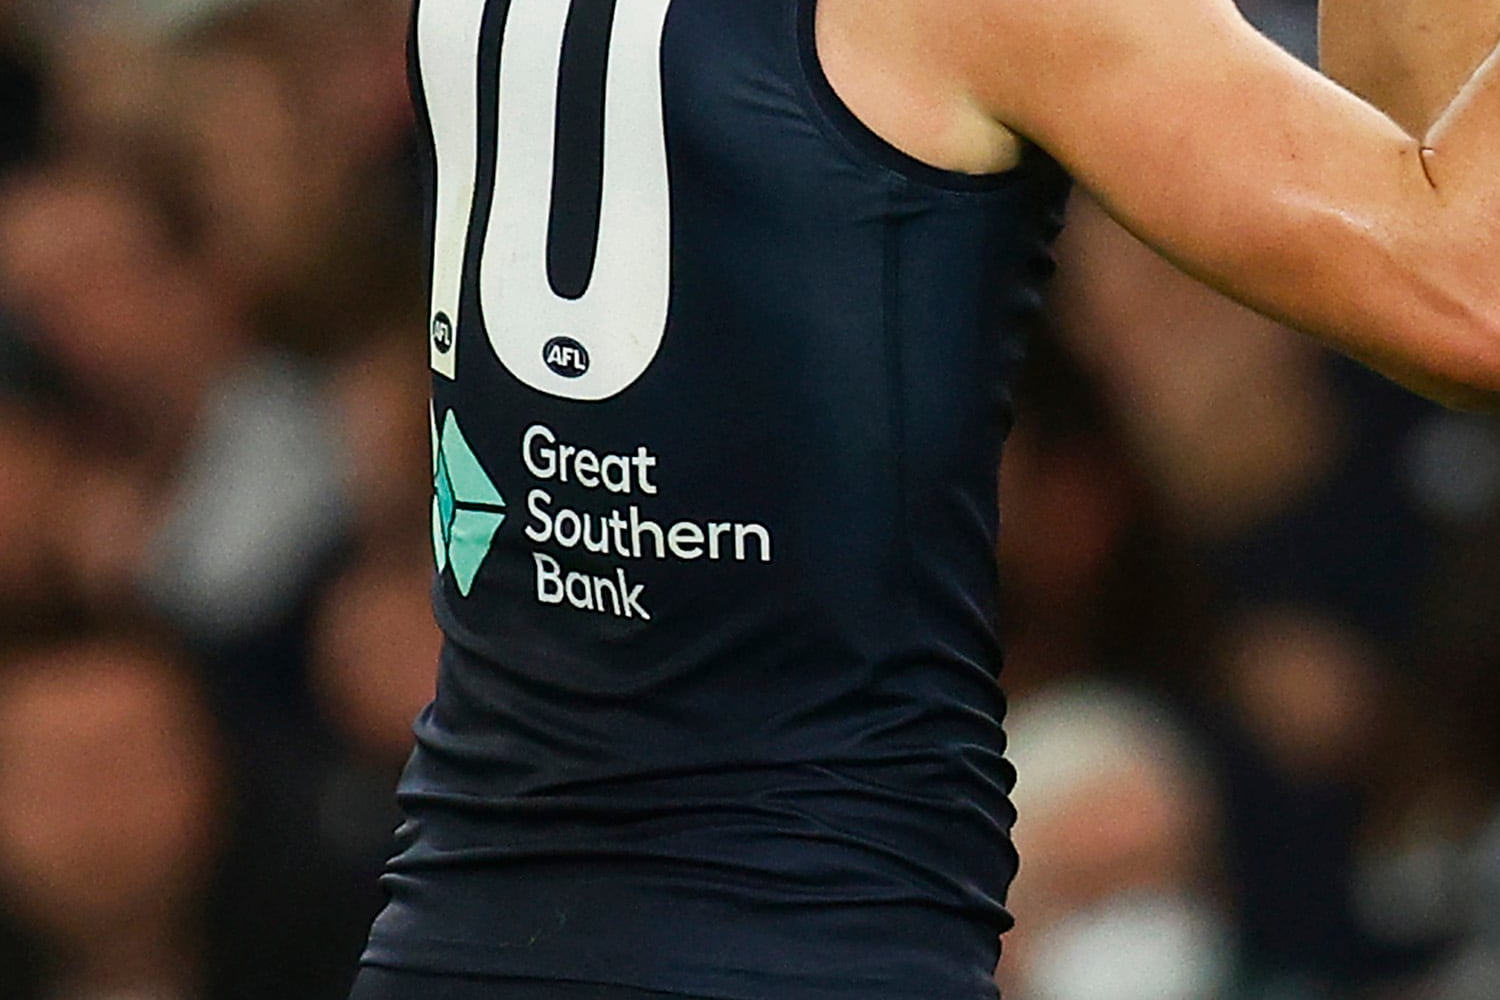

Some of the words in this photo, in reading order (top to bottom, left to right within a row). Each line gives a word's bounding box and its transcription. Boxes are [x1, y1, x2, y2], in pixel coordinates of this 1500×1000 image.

[546, 344, 586, 371] AFL
[522, 424, 658, 495] Great
[524, 489, 771, 562] Southern
[533, 552, 651, 621] Bank
